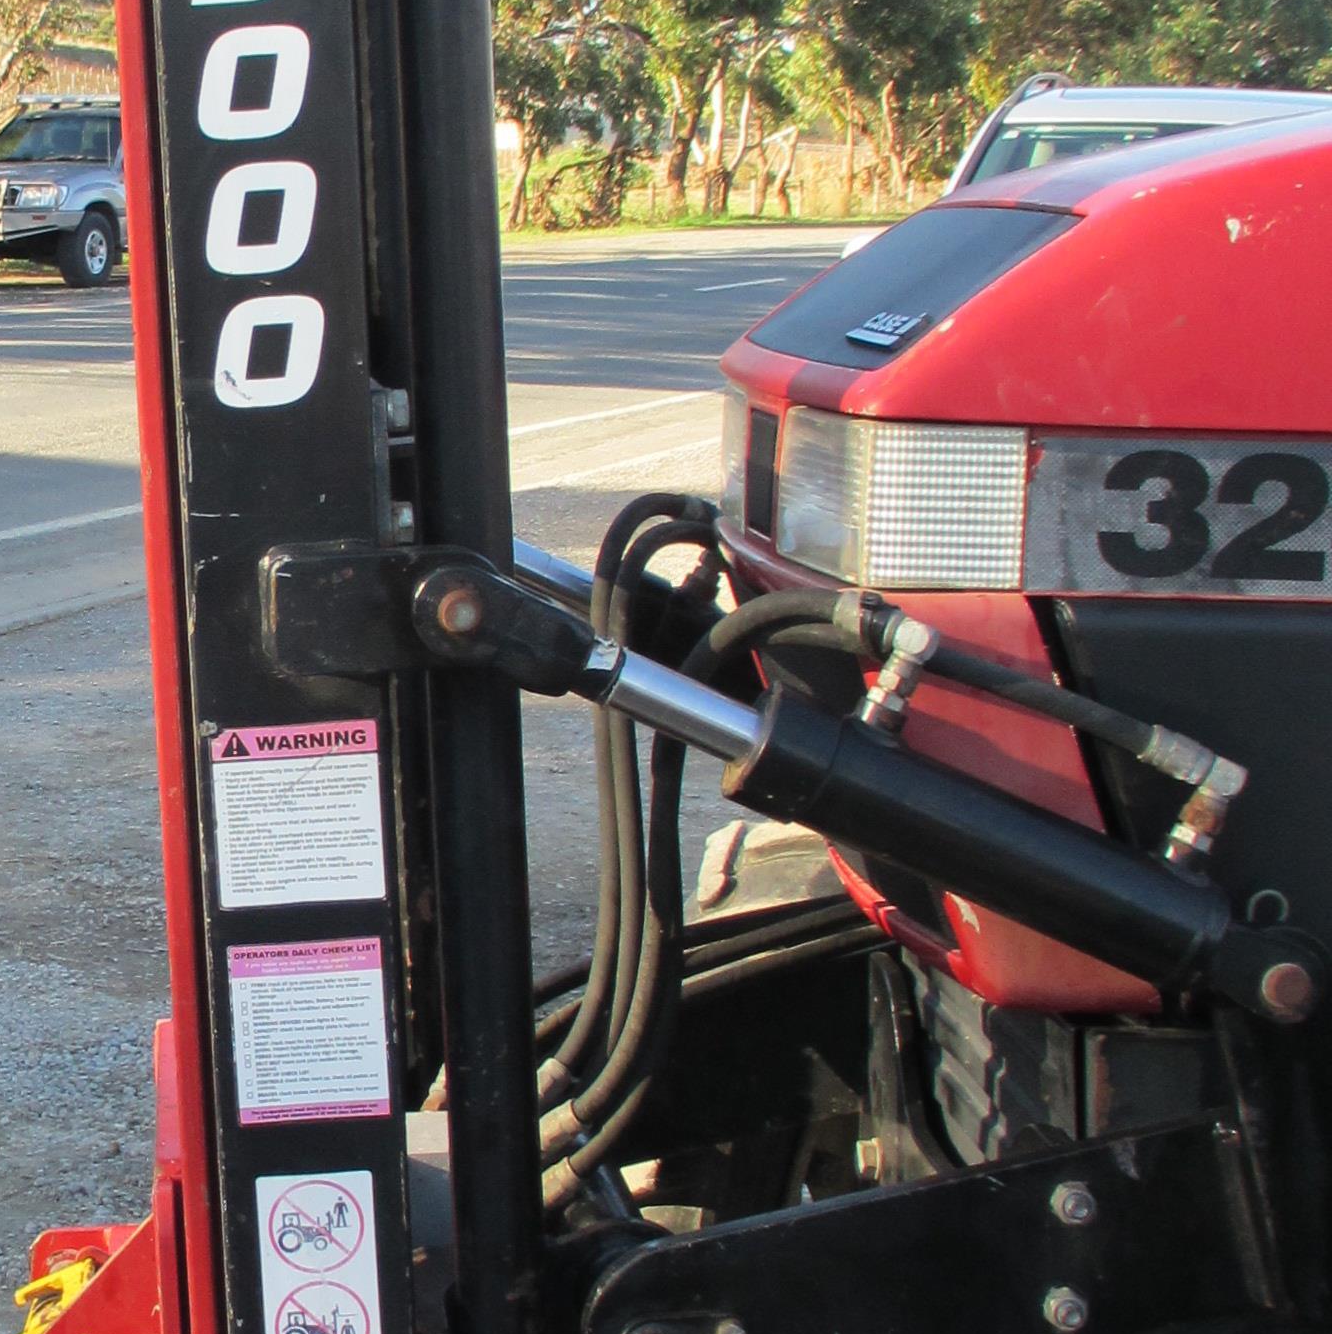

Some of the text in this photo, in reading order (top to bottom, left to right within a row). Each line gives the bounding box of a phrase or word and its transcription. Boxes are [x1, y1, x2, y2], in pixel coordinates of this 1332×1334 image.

[255, 729, 367, 752] WARNING
[233, 943, 377, 960] OPERATORS DAILY CHECK LIST
